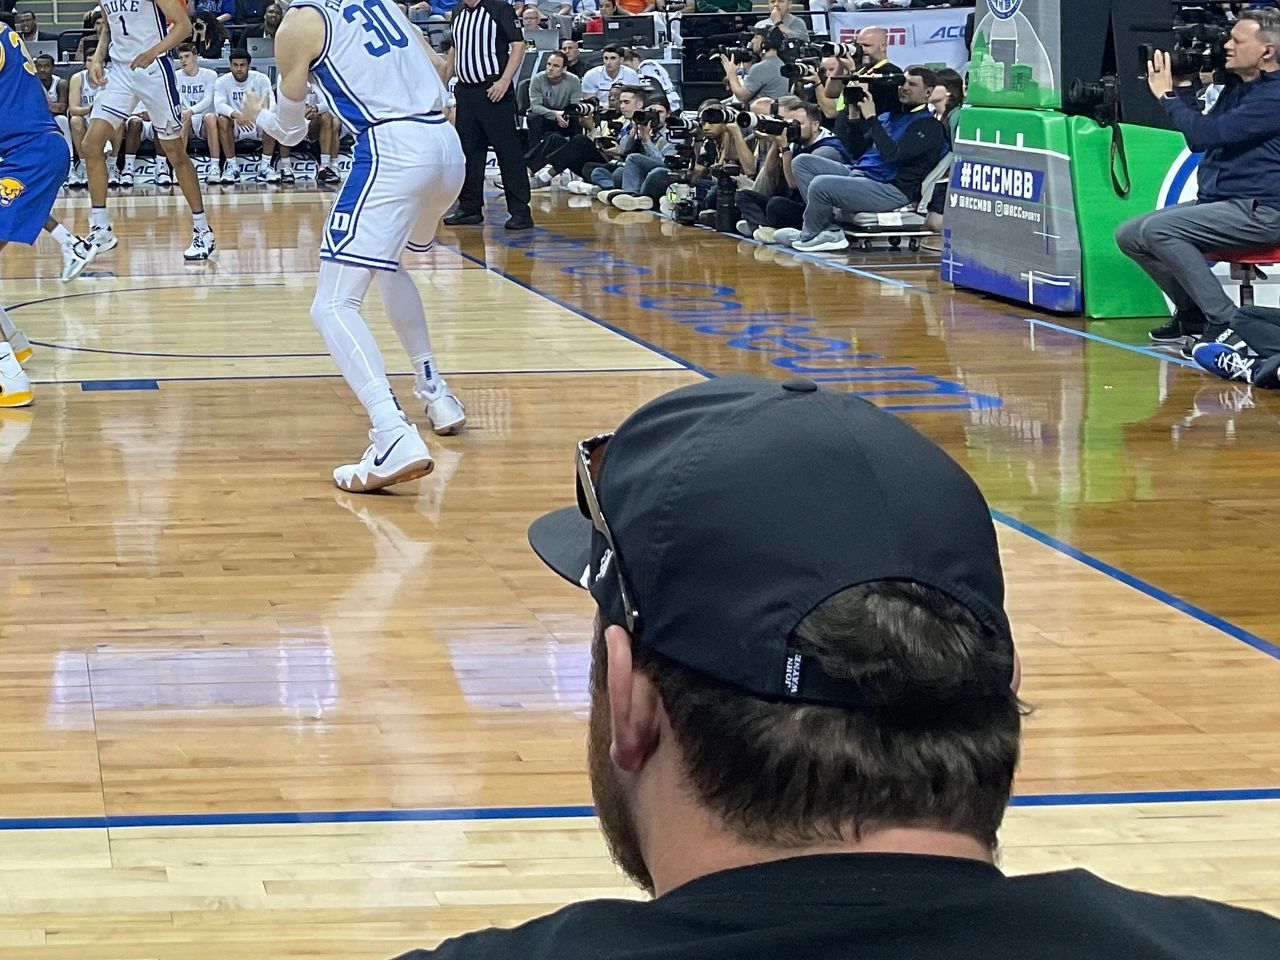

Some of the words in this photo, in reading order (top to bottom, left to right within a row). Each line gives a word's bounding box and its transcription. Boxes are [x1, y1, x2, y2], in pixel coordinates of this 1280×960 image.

[103, 0, 140, 15] DUKE
[118, 15, 130, 36] 1
[181, 84, 205, 94] DUKE
[960, 162, 1034, 199] #ACCMBB
[958, 195, 992, 213] @ACCMBB
[785, 657, 794, 689] JOHN
[790, 654, 802, 693] WAYNE
